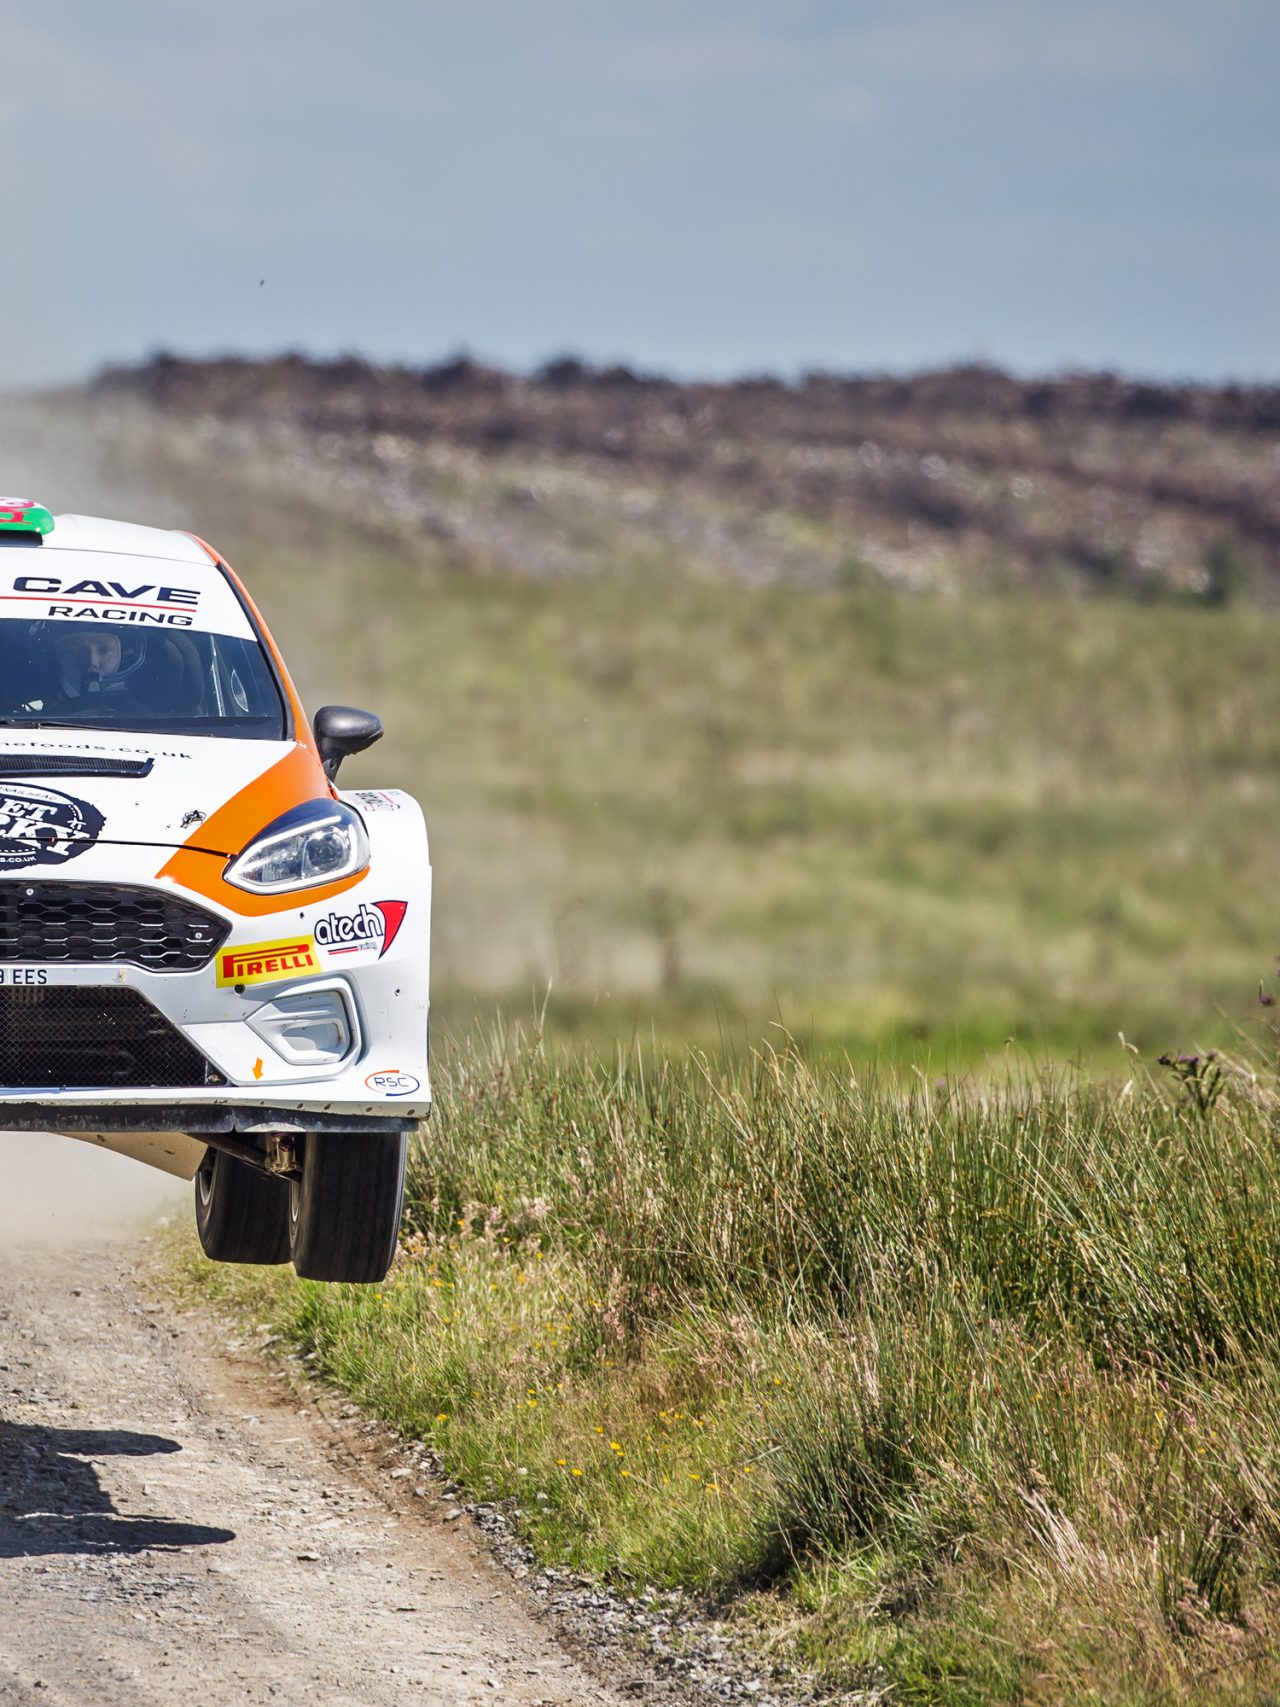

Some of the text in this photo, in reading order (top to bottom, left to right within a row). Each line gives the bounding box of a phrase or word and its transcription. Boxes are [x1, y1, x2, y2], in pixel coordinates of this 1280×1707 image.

[13, 577, 201, 605] CAVE
[48, 606, 193, 626] RACING
[314, 904, 384, 945] atech
[222, 943, 314, 978] PIRELLI
[12, 968, 48, 985] EES
[373, 1076, 410, 1088] RSC
